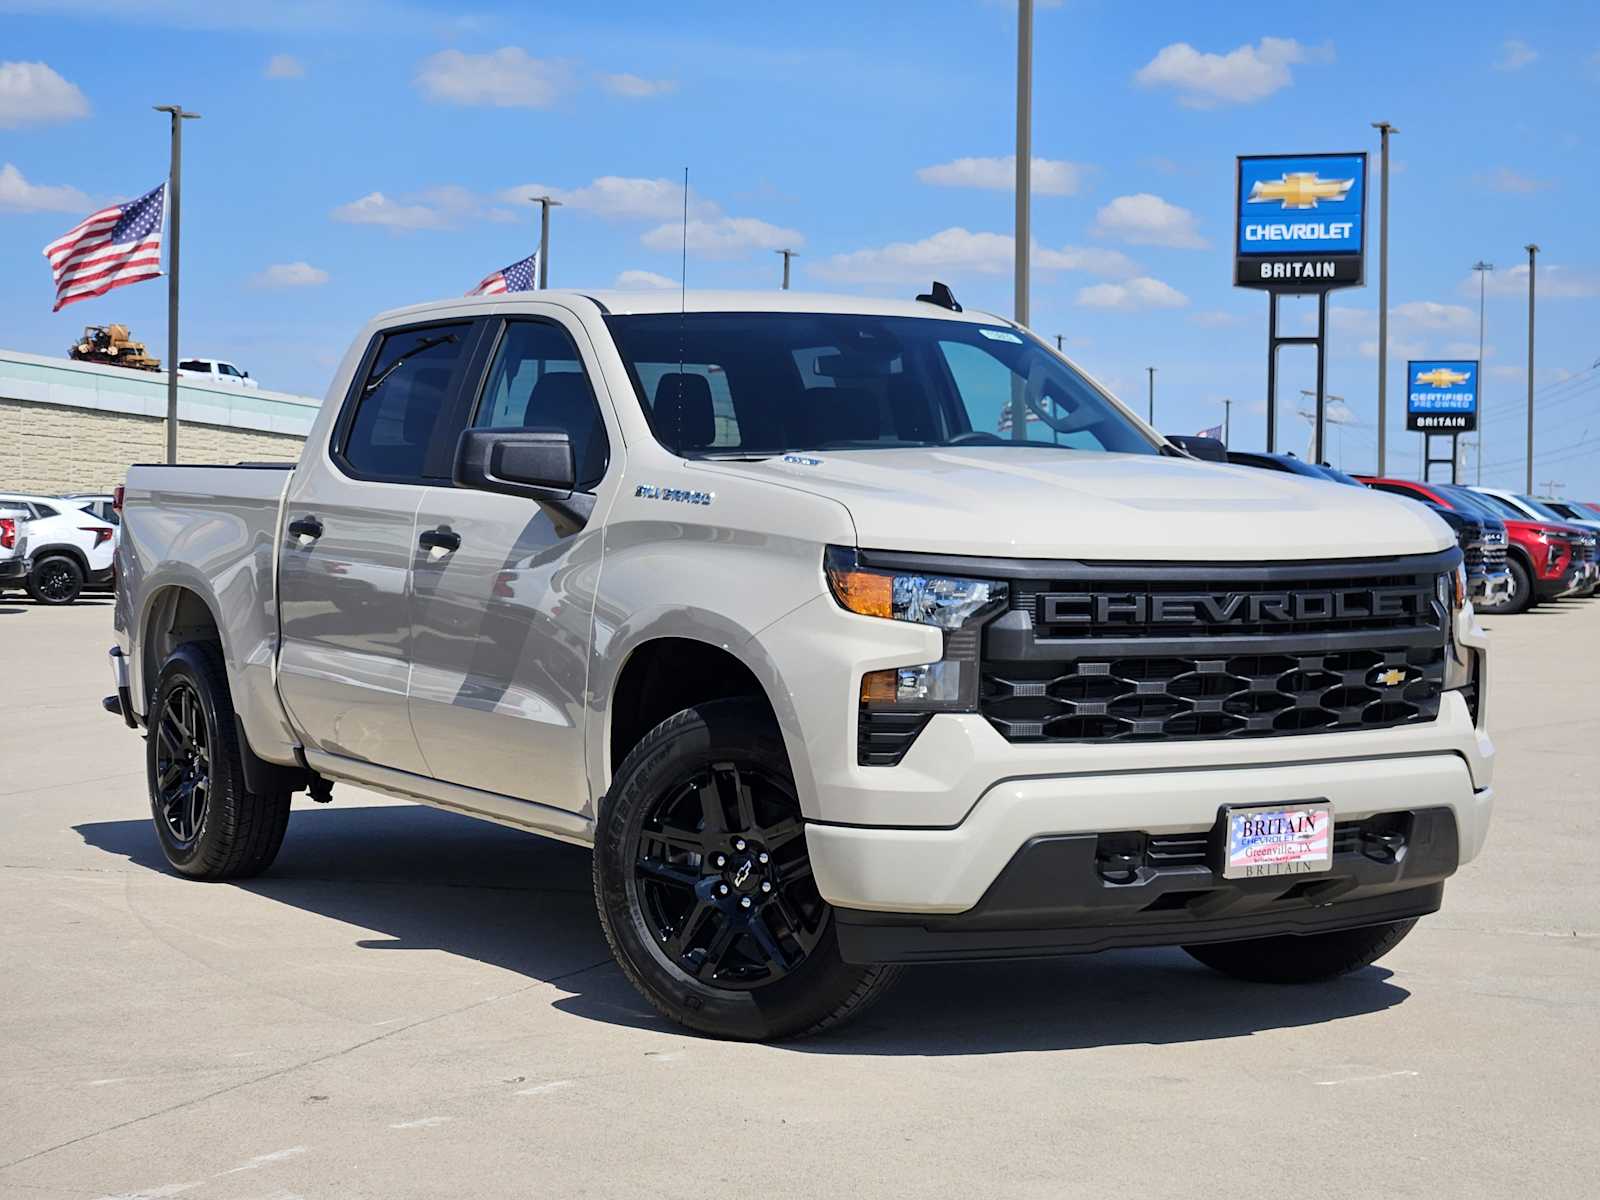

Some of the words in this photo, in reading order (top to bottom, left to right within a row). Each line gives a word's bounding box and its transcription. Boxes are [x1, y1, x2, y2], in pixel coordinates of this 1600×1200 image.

[1245, 222, 1353, 241] CHEVROLET
[1260, 262, 1336, 278] BRITAIN
[1416, 417, 1466, 427] BRITAIN
[1038, 588, 1434, 625] CHEVROLET
[1243, 815, 1316, 837] BRITAIN
[1241, 835, 1295, 845] CHEVROLET
[1297, 842, 1312, 852] TX
[1246, 862, 1312, 876] BRITAIN
